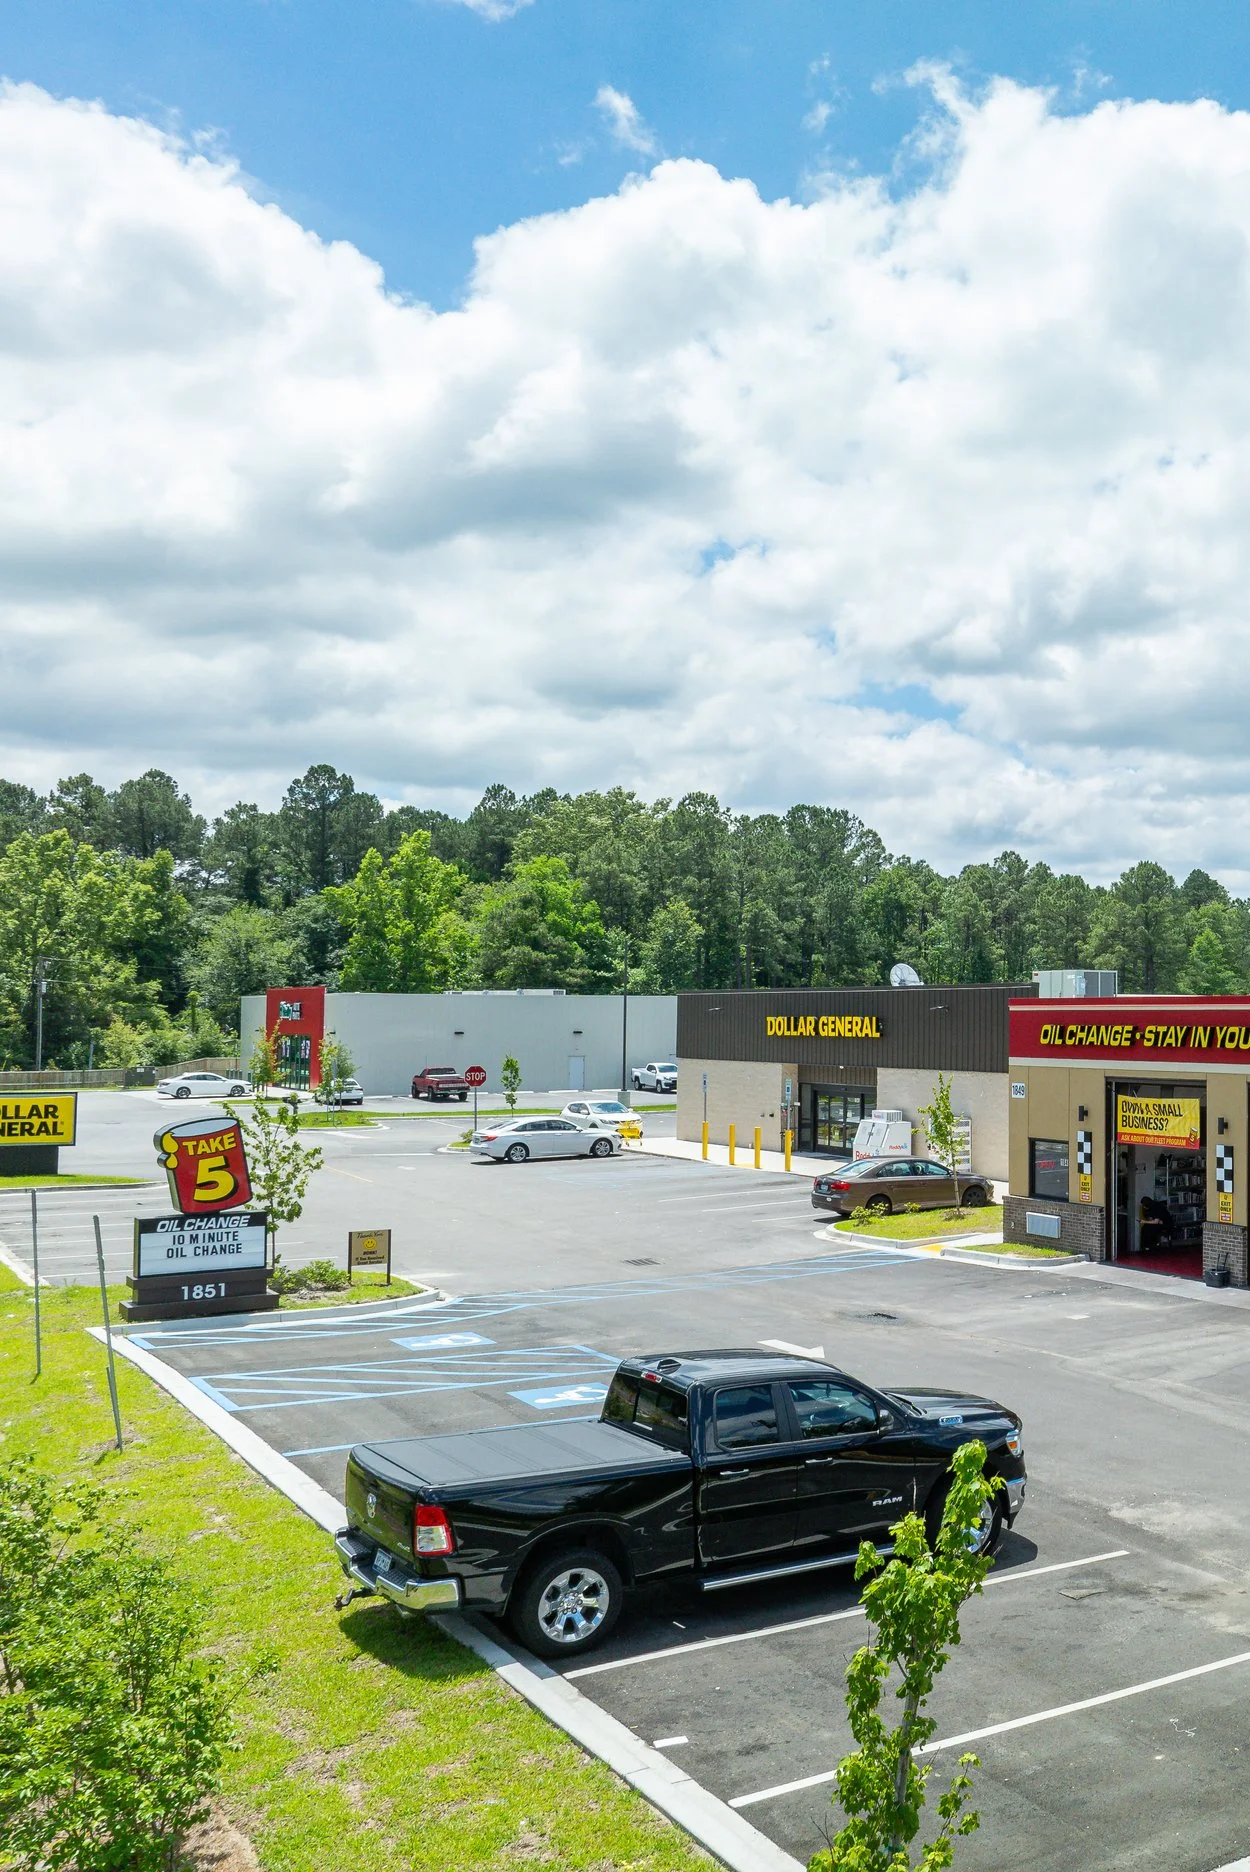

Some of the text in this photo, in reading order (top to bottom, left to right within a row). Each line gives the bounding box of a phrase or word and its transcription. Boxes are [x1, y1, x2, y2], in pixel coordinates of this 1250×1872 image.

[766, 1016, 880, 1038] DOLLAR GENERAL
[1040, 1024, 1062, 1045] OIL
[1065, 1025, 1133, 1046] CHANGE
[1143, 1026, 1187, 1048] STAY
[1190, 1026, 1210, 1048] IN
[466, 1072, 486, 1080] STOP
[1012, 1085, 1025, 1096] 1849
[0, 1104, 59, 1119] LLAR
[1122, 1100, 1183, 1117] OWN A SMALL
[1122, 1115, 1169, 1131] BUSINESS?
[182, 1132, 236, 1156] TAKE
[193, 1156, 235, 1202] 5
[156, 1215, 251, 1232] OIL CHANGE
[172, 1231, 239, 1245] 10 MINUTE
[166, 1243, 242, 1259] OIL CHANGE
[181, 1282, 226, 1300] 1851
[872, 1496, 902, 1506] RAM
